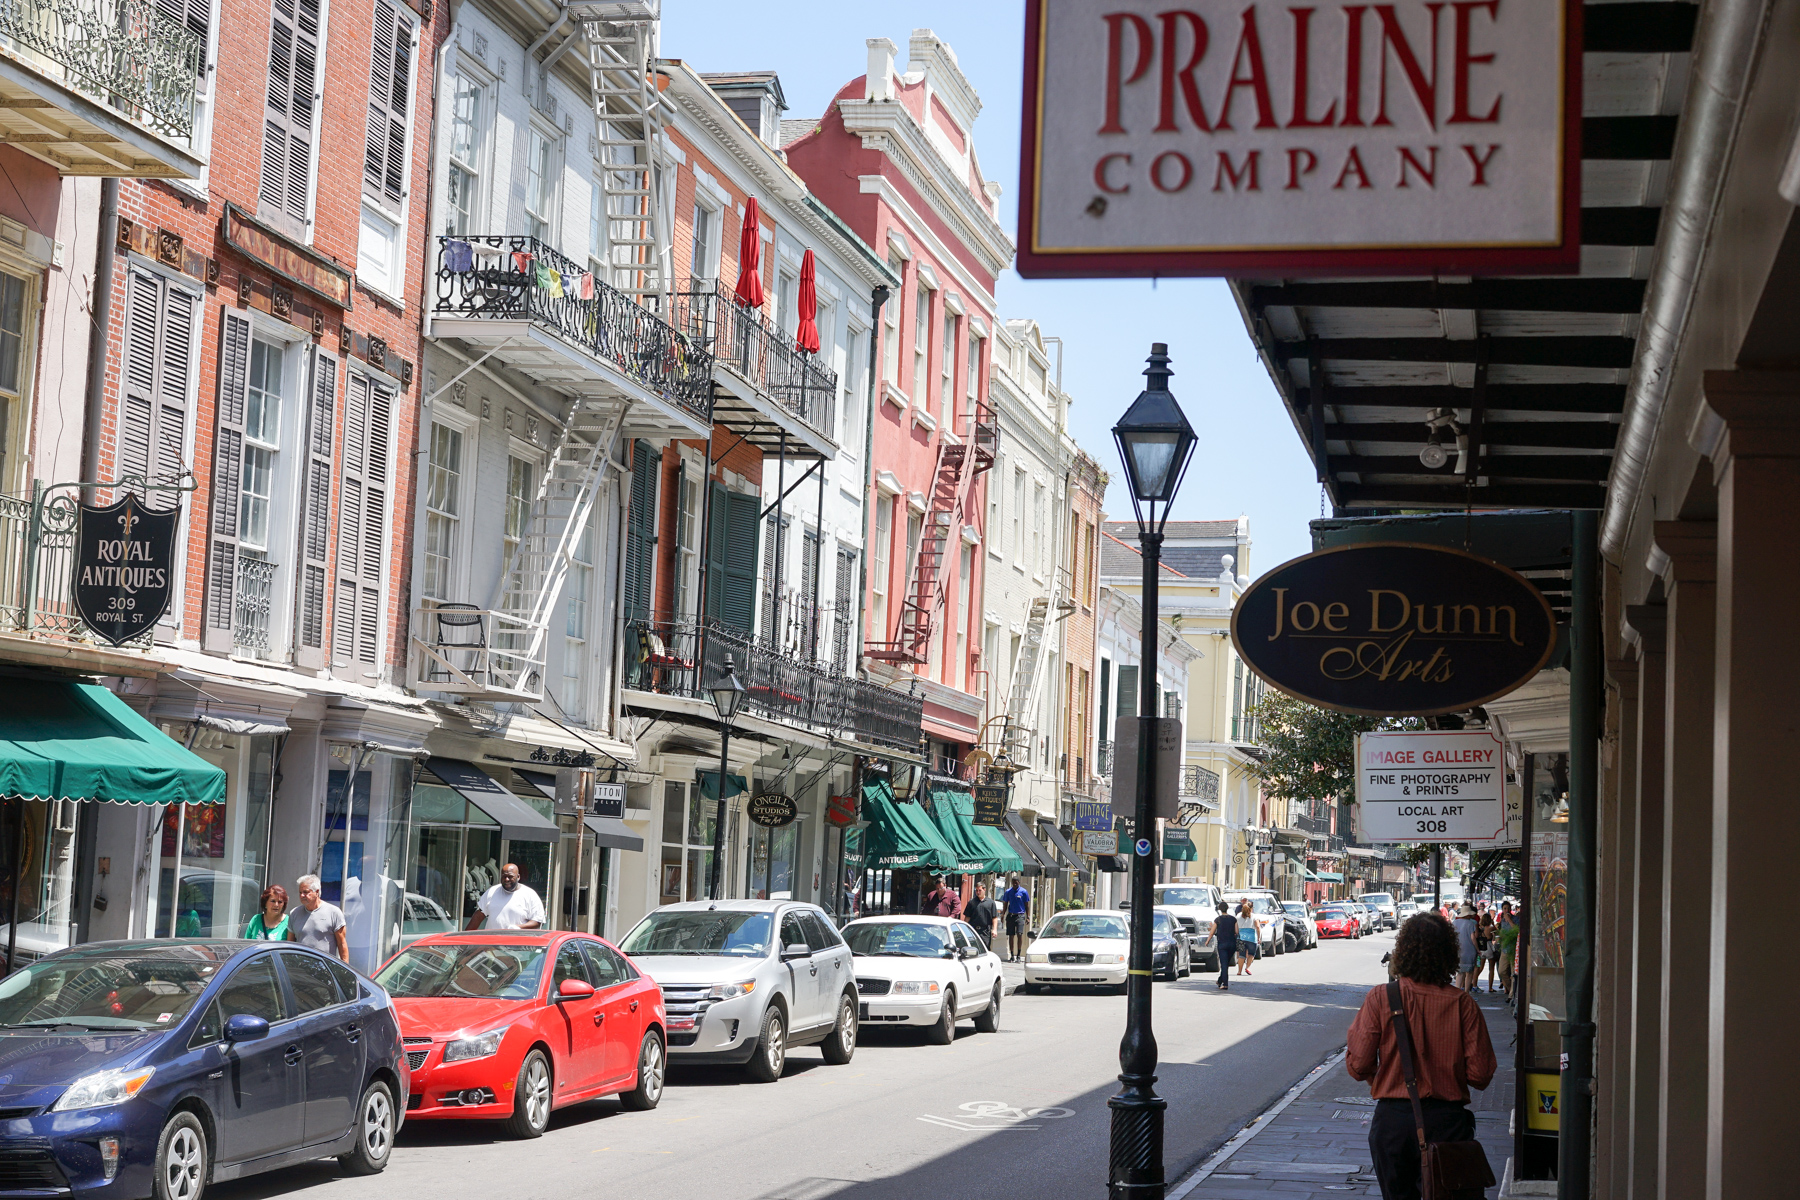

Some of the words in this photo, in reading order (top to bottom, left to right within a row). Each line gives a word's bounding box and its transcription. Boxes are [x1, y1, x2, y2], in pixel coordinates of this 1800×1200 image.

[1097, 0, 1503, 135] PRALINE
[1094, 144, 1501, 194] COMPANY
[97, 539, 154, 564] ROYAL
[80, 565, 166, 594] ANTIQUES
[107, 597, 136, 610] 309
[96, 612, 127, 623] ROYAL
[132, 613, 144, 623] ST.
[1267, 587, 1350, 642] Joe
[1367, 589, 1524, 647] Dunn
[1319, 630, 1455, 683] Arts
[1366, 751, 1416, 764] IMAGE
[1422, 750, 1494, 764] GALLERY
[1370, 774, 1396, 785] FINE
[1401, 773, 1491, 784] PHOTOGRAPHY
[1402, 786, 1411, 795] &
[1416, 785, 1459, 795] PRINTS
[753, 806, 790, 815] STUDIOS
[1079, 804, 1110, 820] VINTAGE
[1398, 806, 1437, 816] LOCAL
[1441, 806, 1464, 816] ART
[1416, 820, 1447, 833] 308
[1086, 838, 1114, 846] VALOBRA
[878, 855, 919, 864] ANTIQUES
